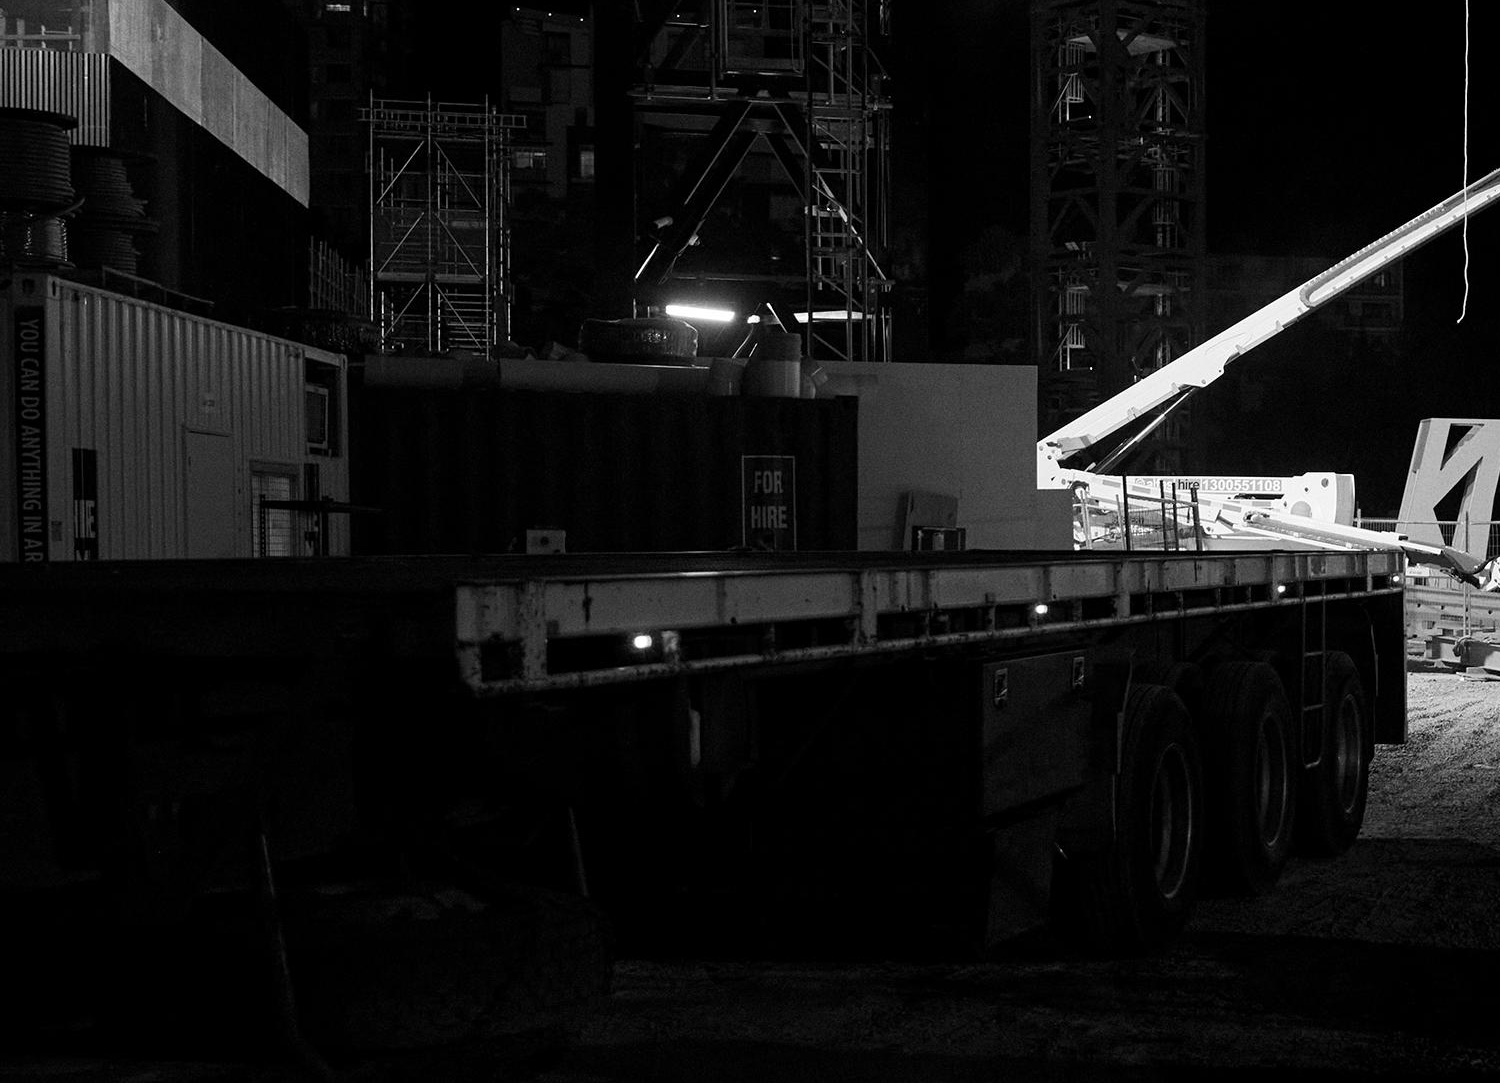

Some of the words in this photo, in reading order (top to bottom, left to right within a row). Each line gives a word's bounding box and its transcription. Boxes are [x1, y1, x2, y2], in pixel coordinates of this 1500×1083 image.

[20, 319, 40, 352] YOU
[20, 357, 40, 391] CAN
[21, 397, 41, 420] DO
[21, 425, 41, 510] ANYTHING
[753, 469, 784, 494] FOR
[1178, 478, 1200, 491] hire
[1203, 479, 1281, 492] 1300551108
[23, 516, 42, 533] IN
[750, 505, 788, 530] HIRE
